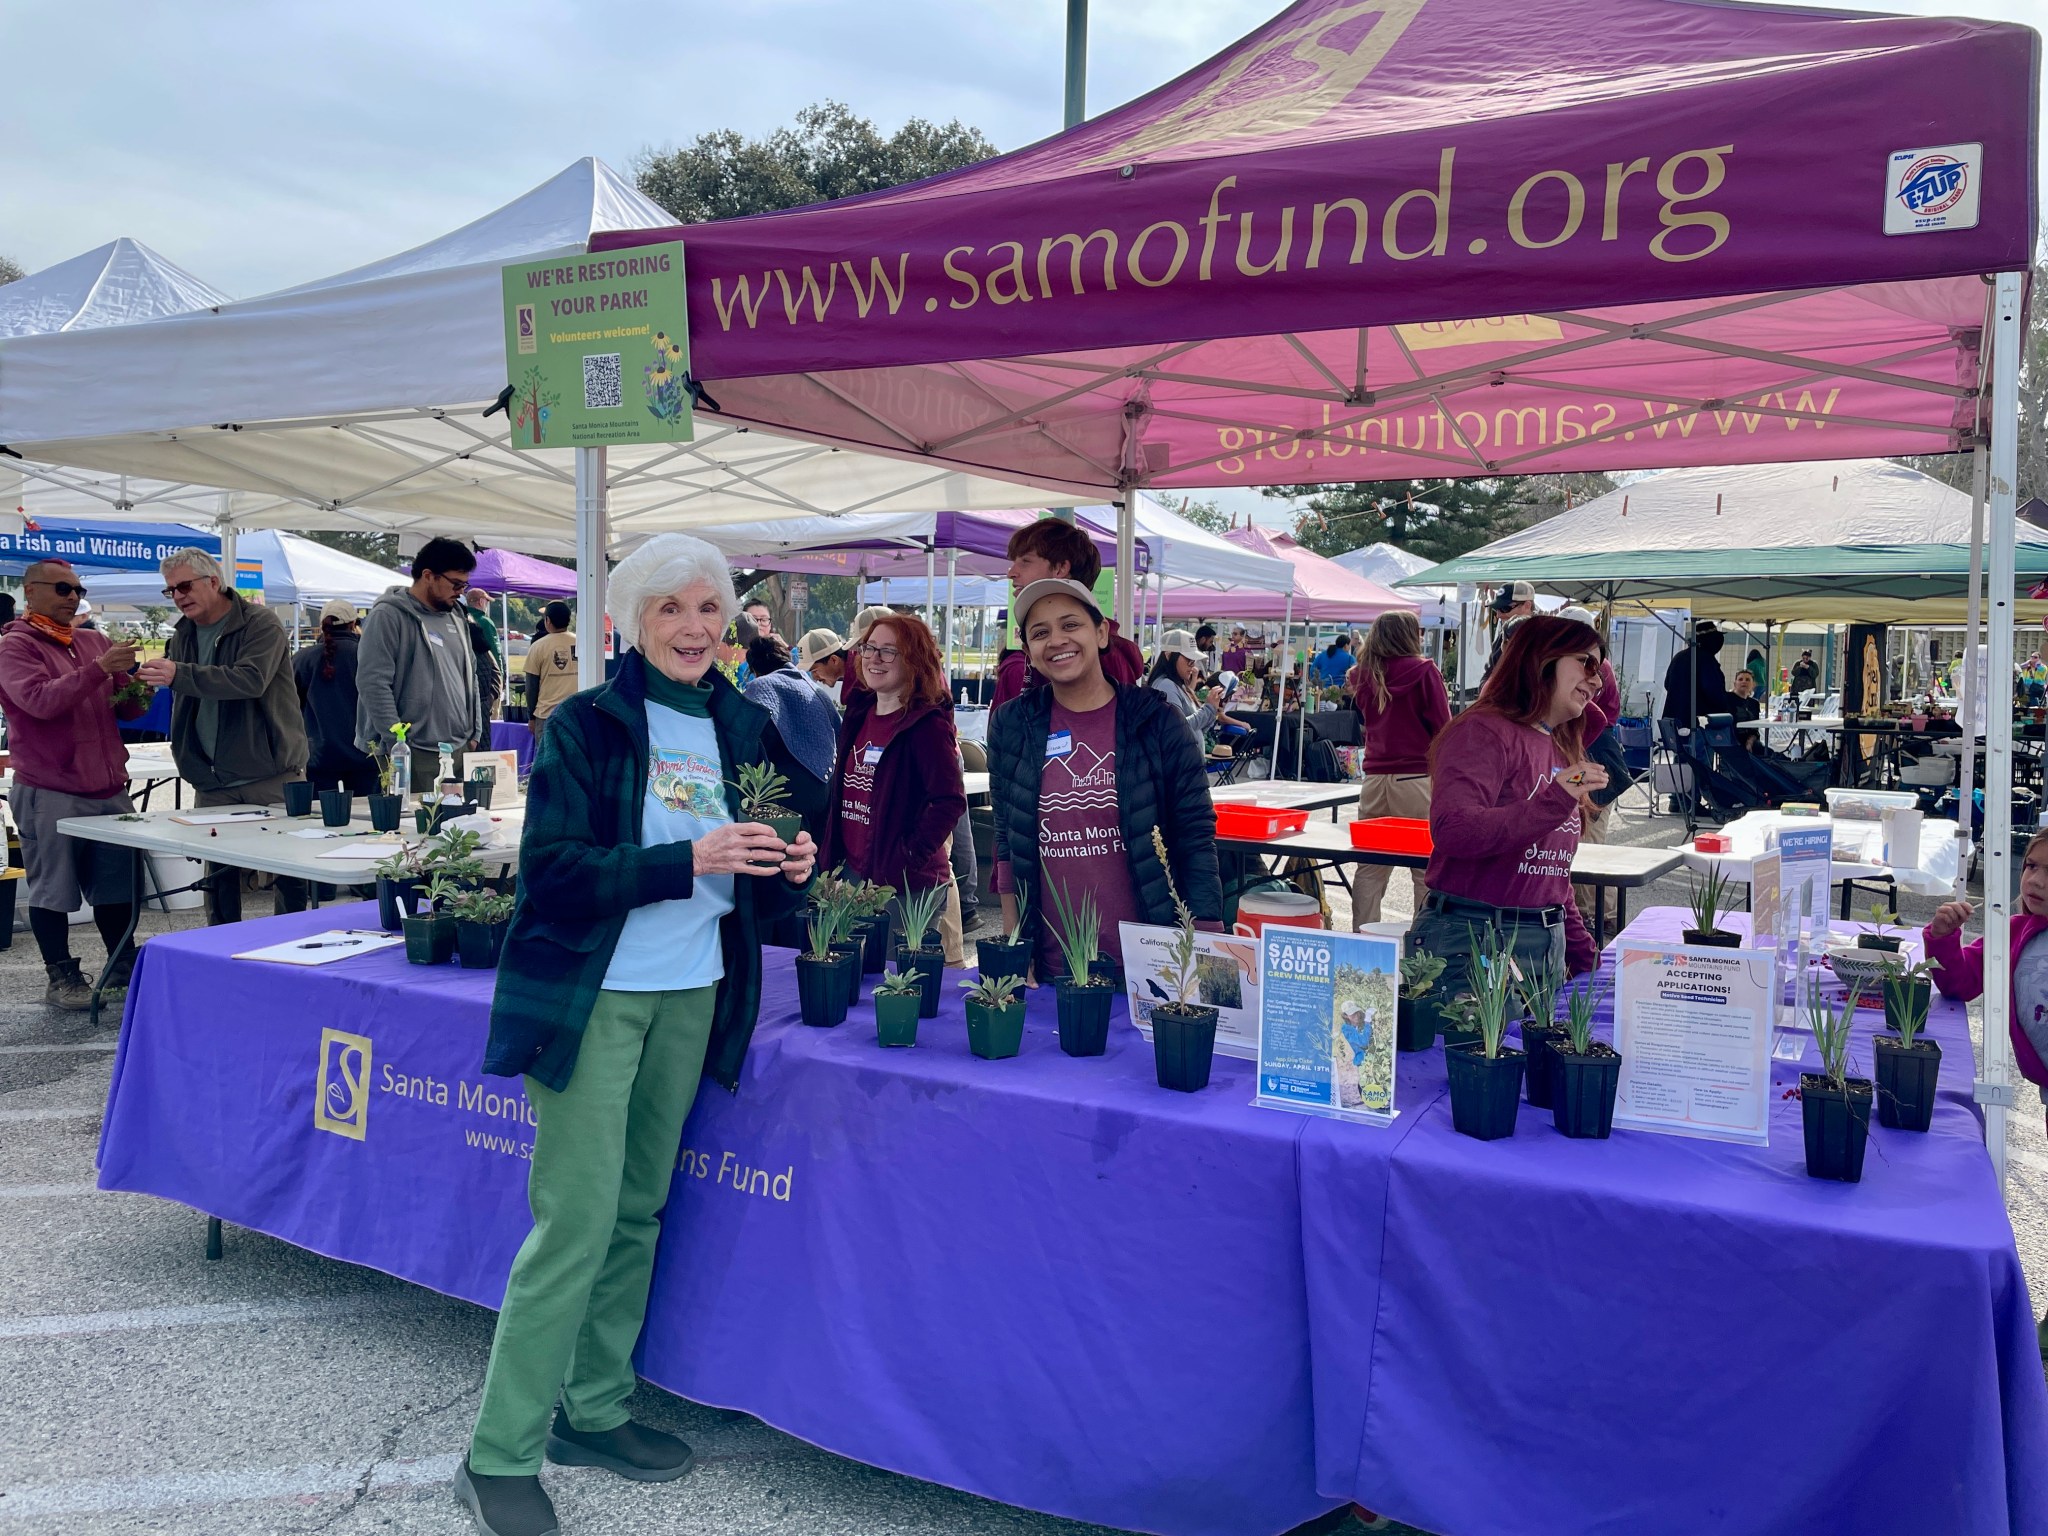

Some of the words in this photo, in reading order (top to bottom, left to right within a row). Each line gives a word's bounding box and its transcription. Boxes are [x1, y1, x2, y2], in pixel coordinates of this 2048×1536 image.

[711, 143, 1734, 332] www.samofund.org
[526, 266, 574, 288] WE'RE
[578, 254, 670, 282] RESTORING
[551, 296, 596, 316] YOUR
[600, 290, 648, 311] PARK!
[550, 328, 601, 344] Volunteers
[604, 324, 650, 340] welcome!
[16, 533, 50, 552] Fish
[56, 537, 86, 554] and
[90, 538, 152, 560] Wildlife
[1039, 818, 1082, 842] Santa
[1086, 826, 1120, 840] Moni
[1039, 843, 1108, 858] Mountains
[1782, 837, 1803, 847] WE'RE
[1804, 836, 1828, 846] HIRING!
[1518, 862, 1568, 877] Mountains
[1268, 943, 1330, 963] SAMO
[1268, 971, 1292, 979] CREW
[1295, 974, 1330, 983] MEMBER
[1270, 958, 1328, 976] YOUTH
[1666, 970, 1722, 981] ACCEPTING
[1657, 981, 1731, 994] APPLICATIONS!
[1264, 1061, 1291, 1069] SUNDAY,
[380, 1064, 448, 1106] Santa
[458, 1080, 538, 1126] Monic
[717, 1151, 794, 1202] Fund
